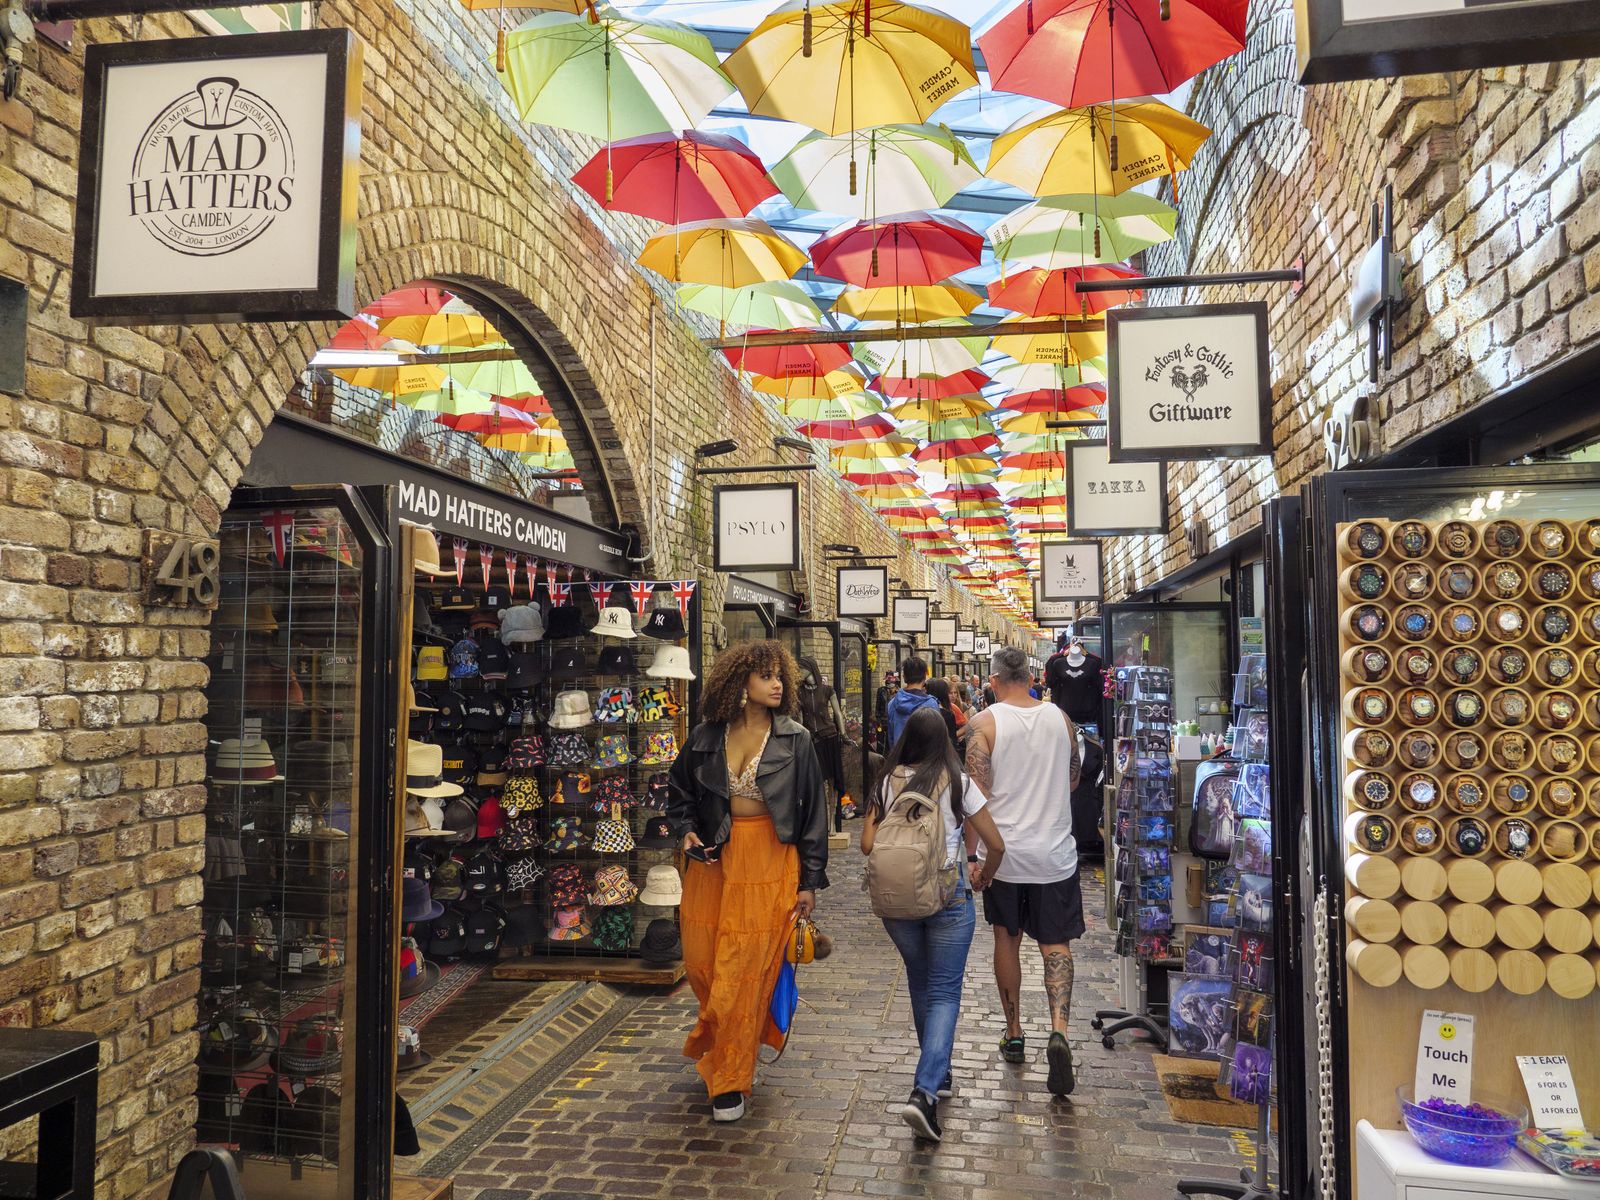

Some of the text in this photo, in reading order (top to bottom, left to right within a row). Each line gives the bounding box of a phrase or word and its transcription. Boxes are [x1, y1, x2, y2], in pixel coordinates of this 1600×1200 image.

[149, 104, 192, 148] HAND MADE
[234, 100, 279, 143] CUSTOM HATS
[160, 132, 267, 174] MAD
[127, 172, 295, 217] HATTERS
[181, 211, 233, 228] CAMDEN
[167, 226, 184, 240] EST
[185, 235, 203, 246] 2004
[215, 224, 250, 245] LONDON
[1144, 342, 1234, 382] Fantasy & Gothic
[1149, 402, 1232, 422] Giftware
[1087, 479, 1146, 495] ZAKKA
[398, 479, 567, 553] MAD HATTERS CAMDEN
[727, 520, 785, 536] PSYLO
[155, 539, 220, 605] 48
[1424, 1045, 1468, 1064] Touch
[1539, 1056, 1567, 1065] EACH
[1432, 1073, 1456, 1088] Me
